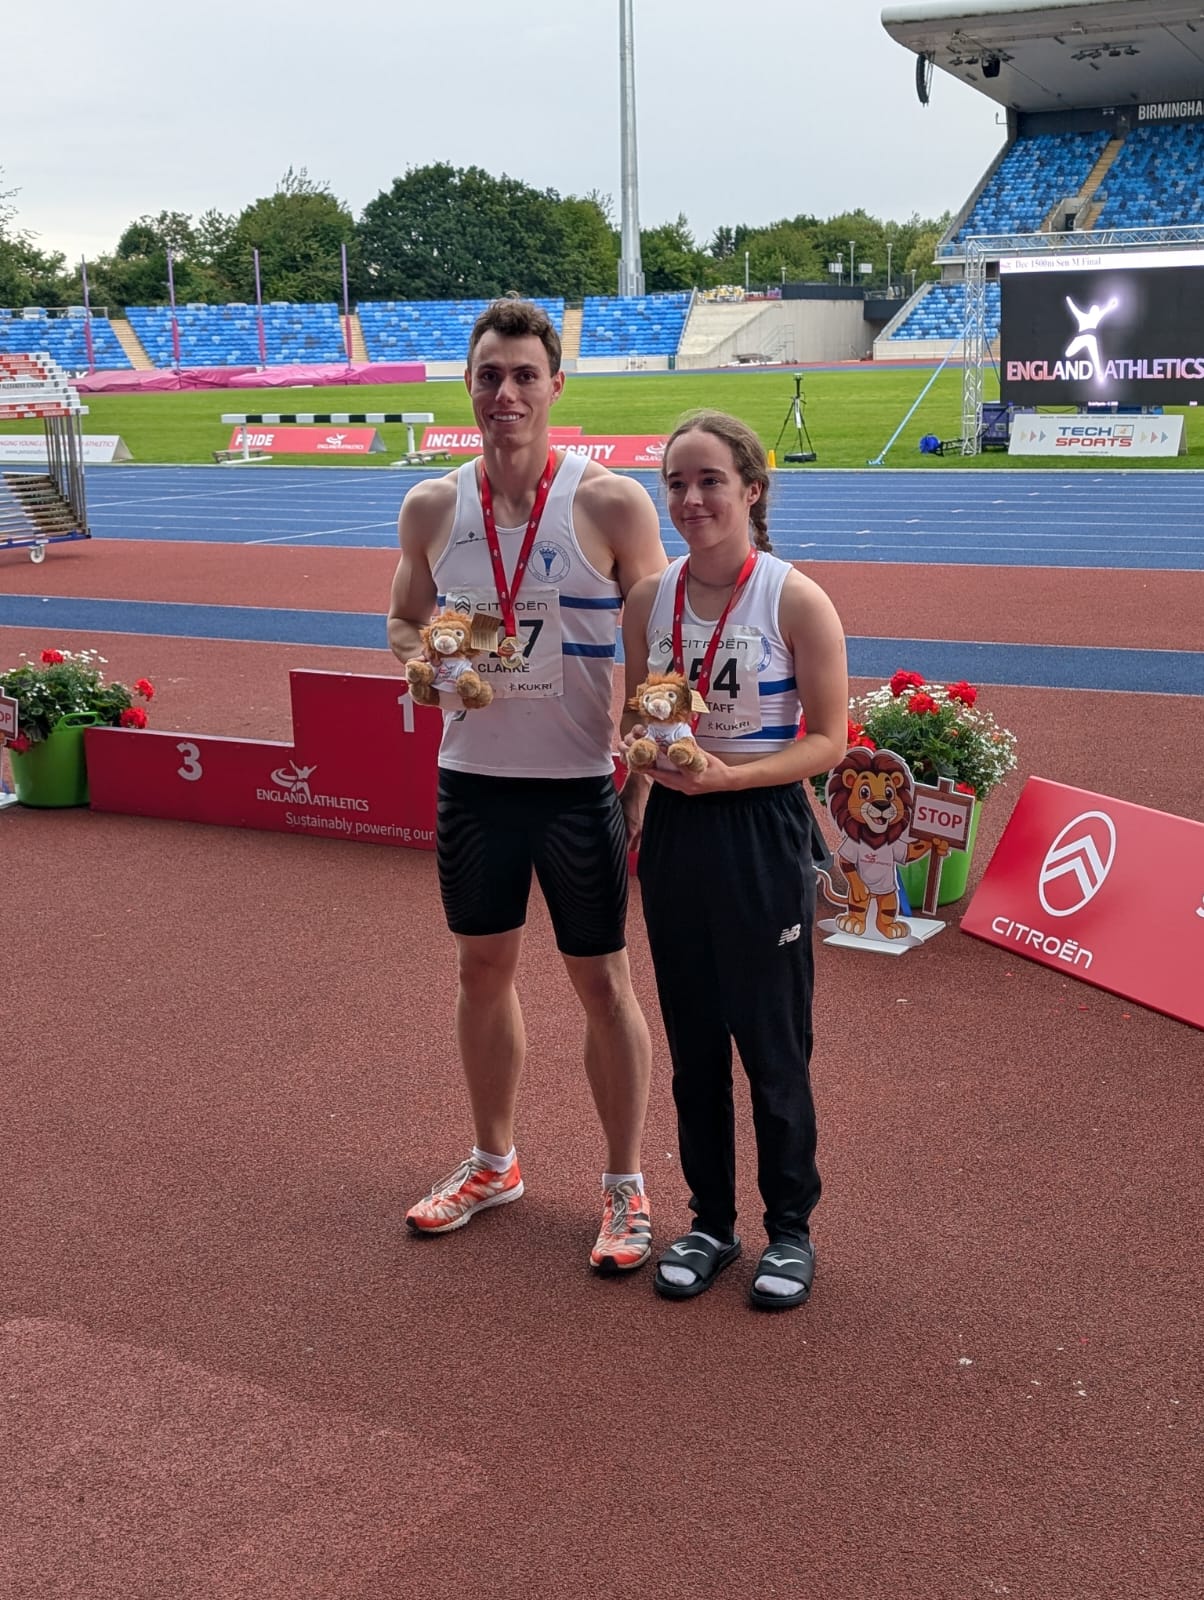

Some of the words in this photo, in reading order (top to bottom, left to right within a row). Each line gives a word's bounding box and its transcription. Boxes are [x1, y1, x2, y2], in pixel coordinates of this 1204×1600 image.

[1007, 360, 1094, 381] ENGLAND
[1104, 358, 1204, 379] ATHLETICS
[235, 433, 275, 447] PRIDE
[1058, 426, 1112, 436] TECH
[1055, 437, 1133, 447] SPORTS
[476, 600, 548, 611] CITOËN
[518, 682, 552, 691] KUKRI
[397, 692, 415, 733] 1
[715, 721, 750, 731] KUKRI
[176, 742, 203, 781] 3
[256, 788, 307, 804] ENGLAND
[312, 794, 369, 812] ATHLETICS
[285, 811, 353, 834] Sustainably
[355, 821, 411, 841] powering
[413, 829, 435, 841] our
[917, 806, 963, 829] STOP
